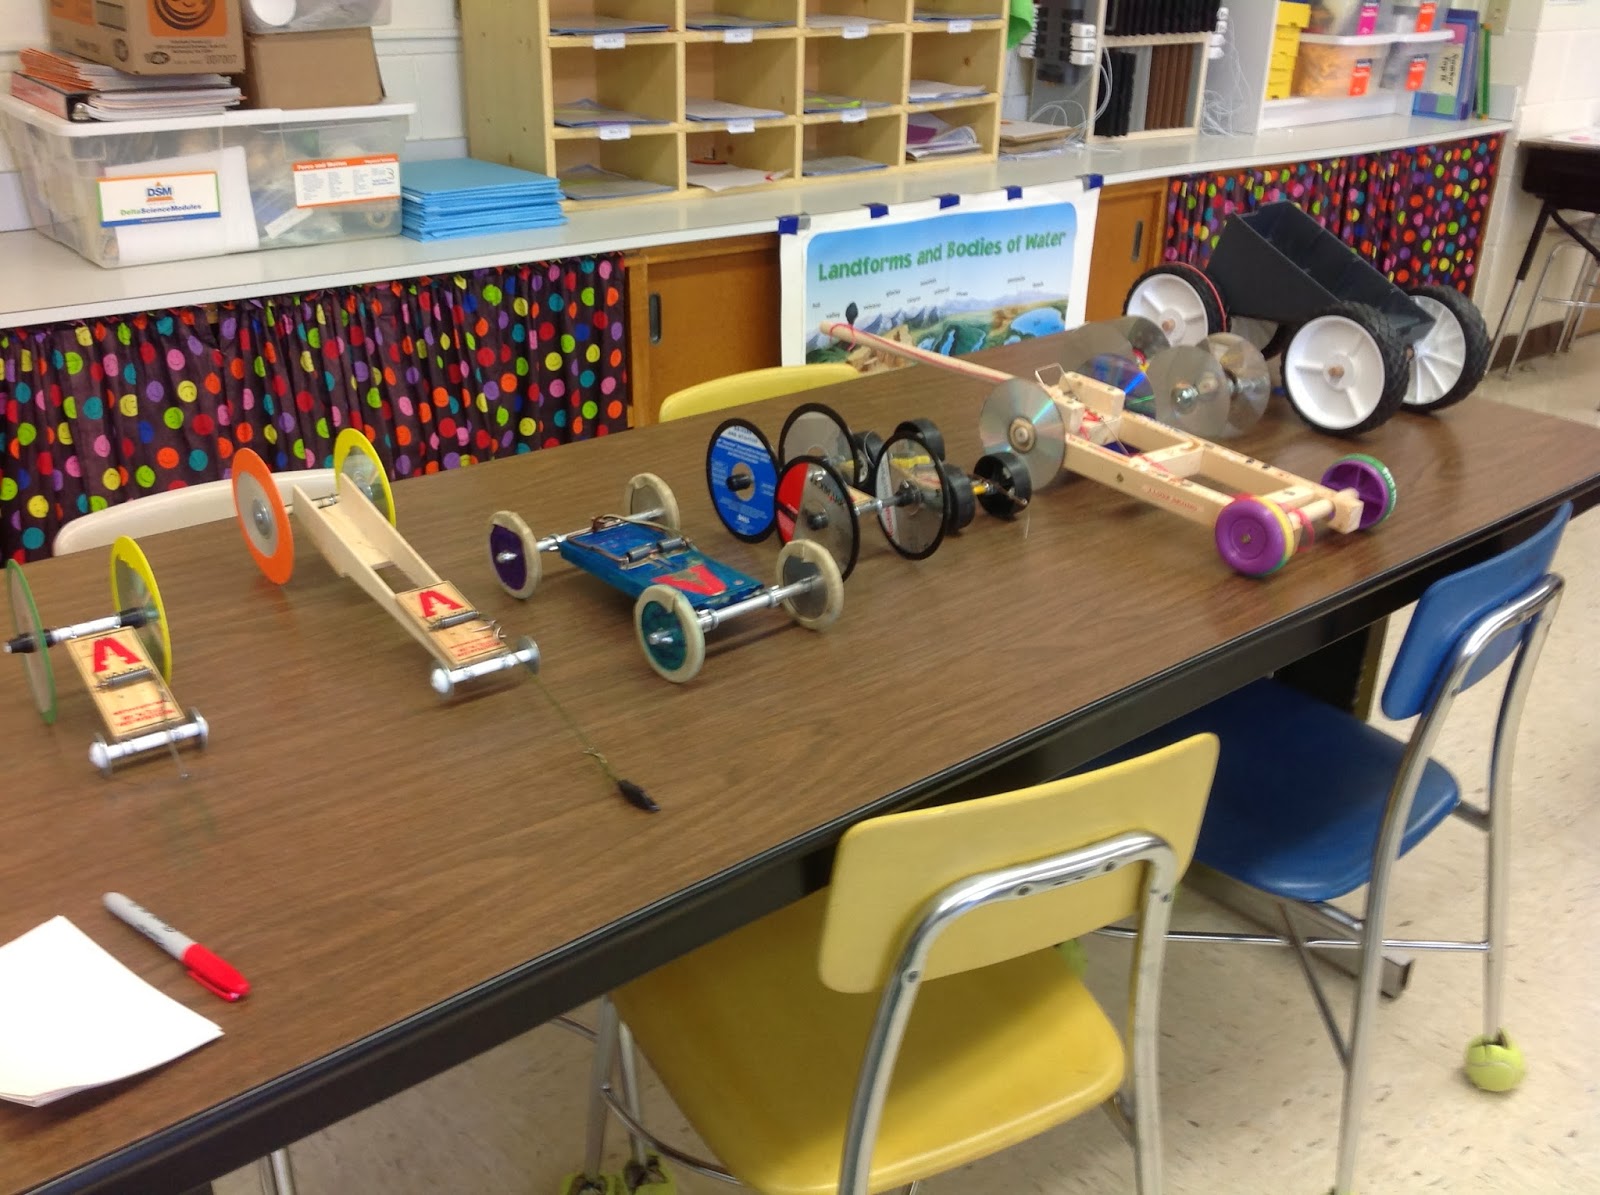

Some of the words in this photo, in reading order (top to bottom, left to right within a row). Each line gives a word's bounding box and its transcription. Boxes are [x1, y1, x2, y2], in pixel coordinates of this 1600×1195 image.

[146, 187, 172, 197] DSM
[818, 250, 912, 281] Landforms
[917, 243, 943, 265] and
[947, 237, 1002, 259] Bodies
[1007, 235, 1021, 250] of
[1025, 231, 1067, 251] Water
